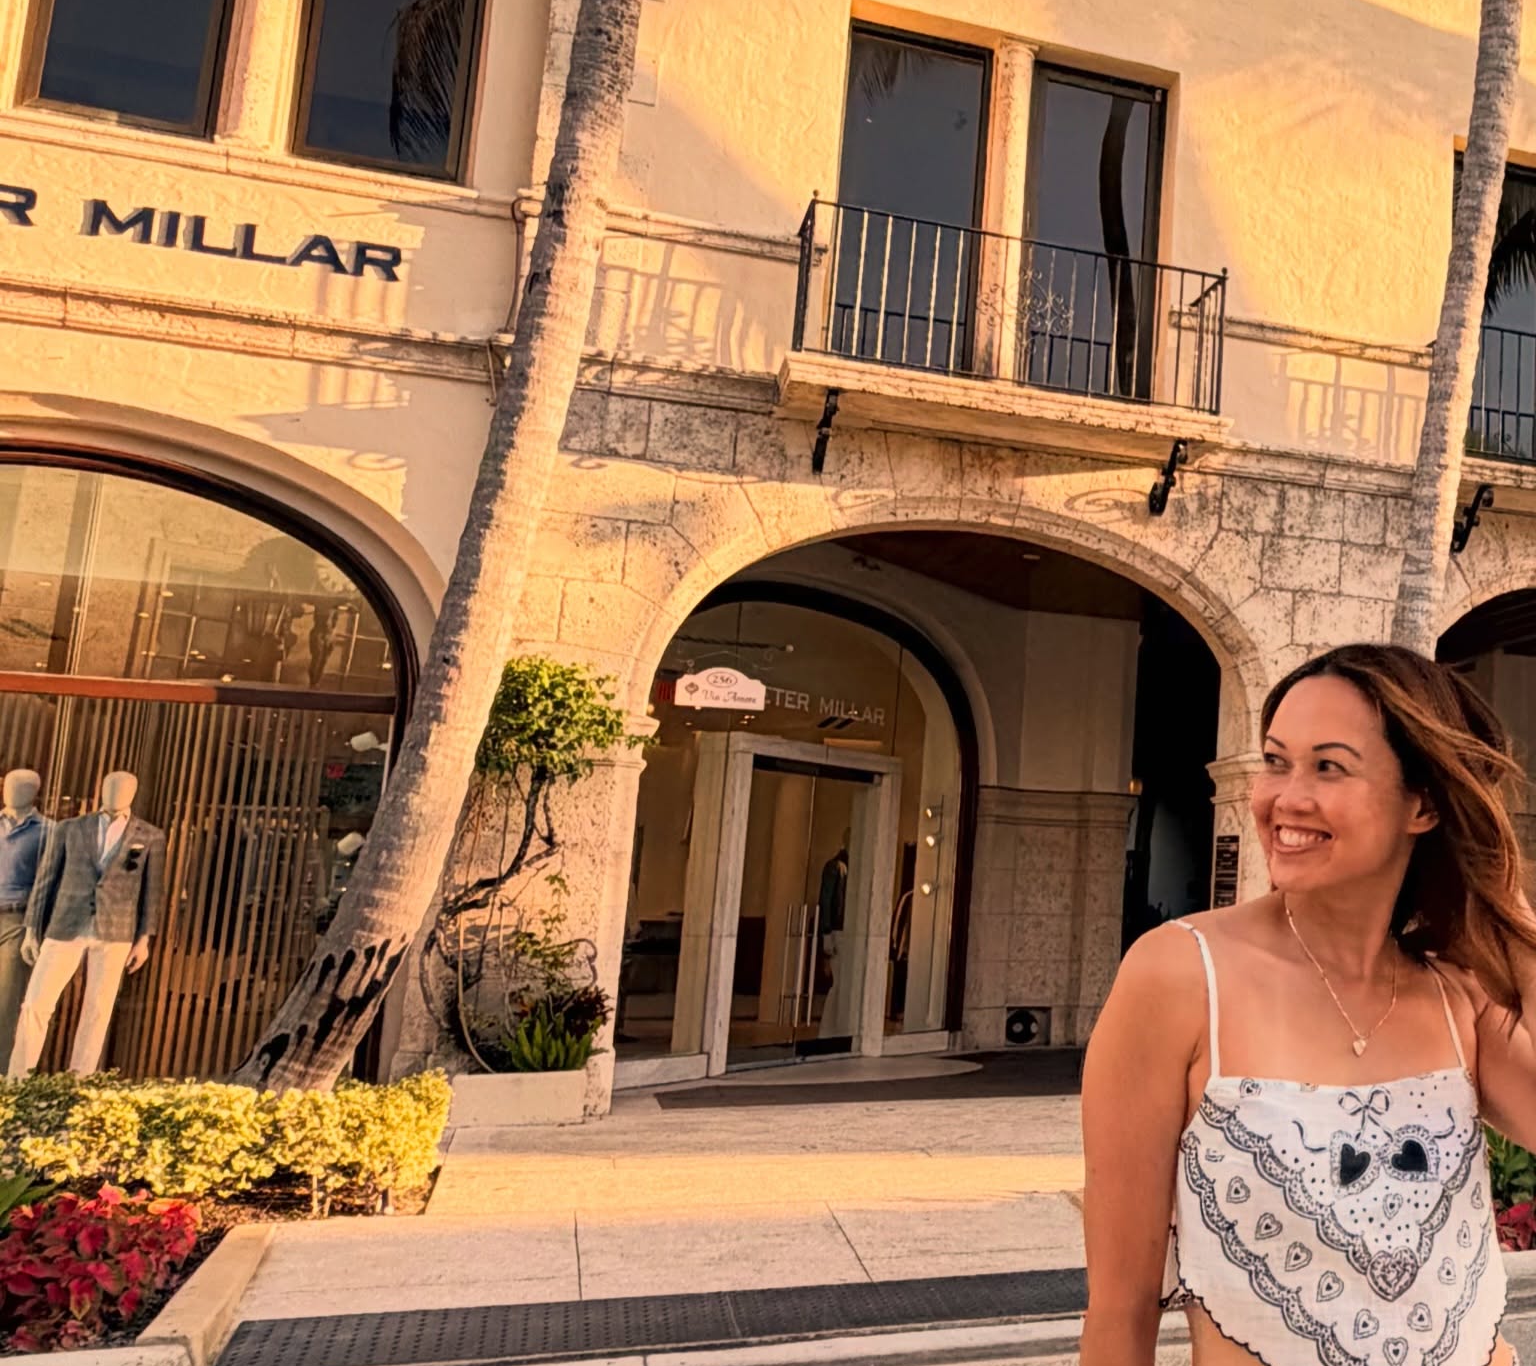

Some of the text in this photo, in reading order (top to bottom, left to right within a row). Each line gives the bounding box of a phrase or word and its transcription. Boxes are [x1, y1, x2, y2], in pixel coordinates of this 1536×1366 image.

[79, 198, 402, 283] MILLAR
[712, 674, 733, 684] 256
[819, 697, 885, 726] MILLAR
